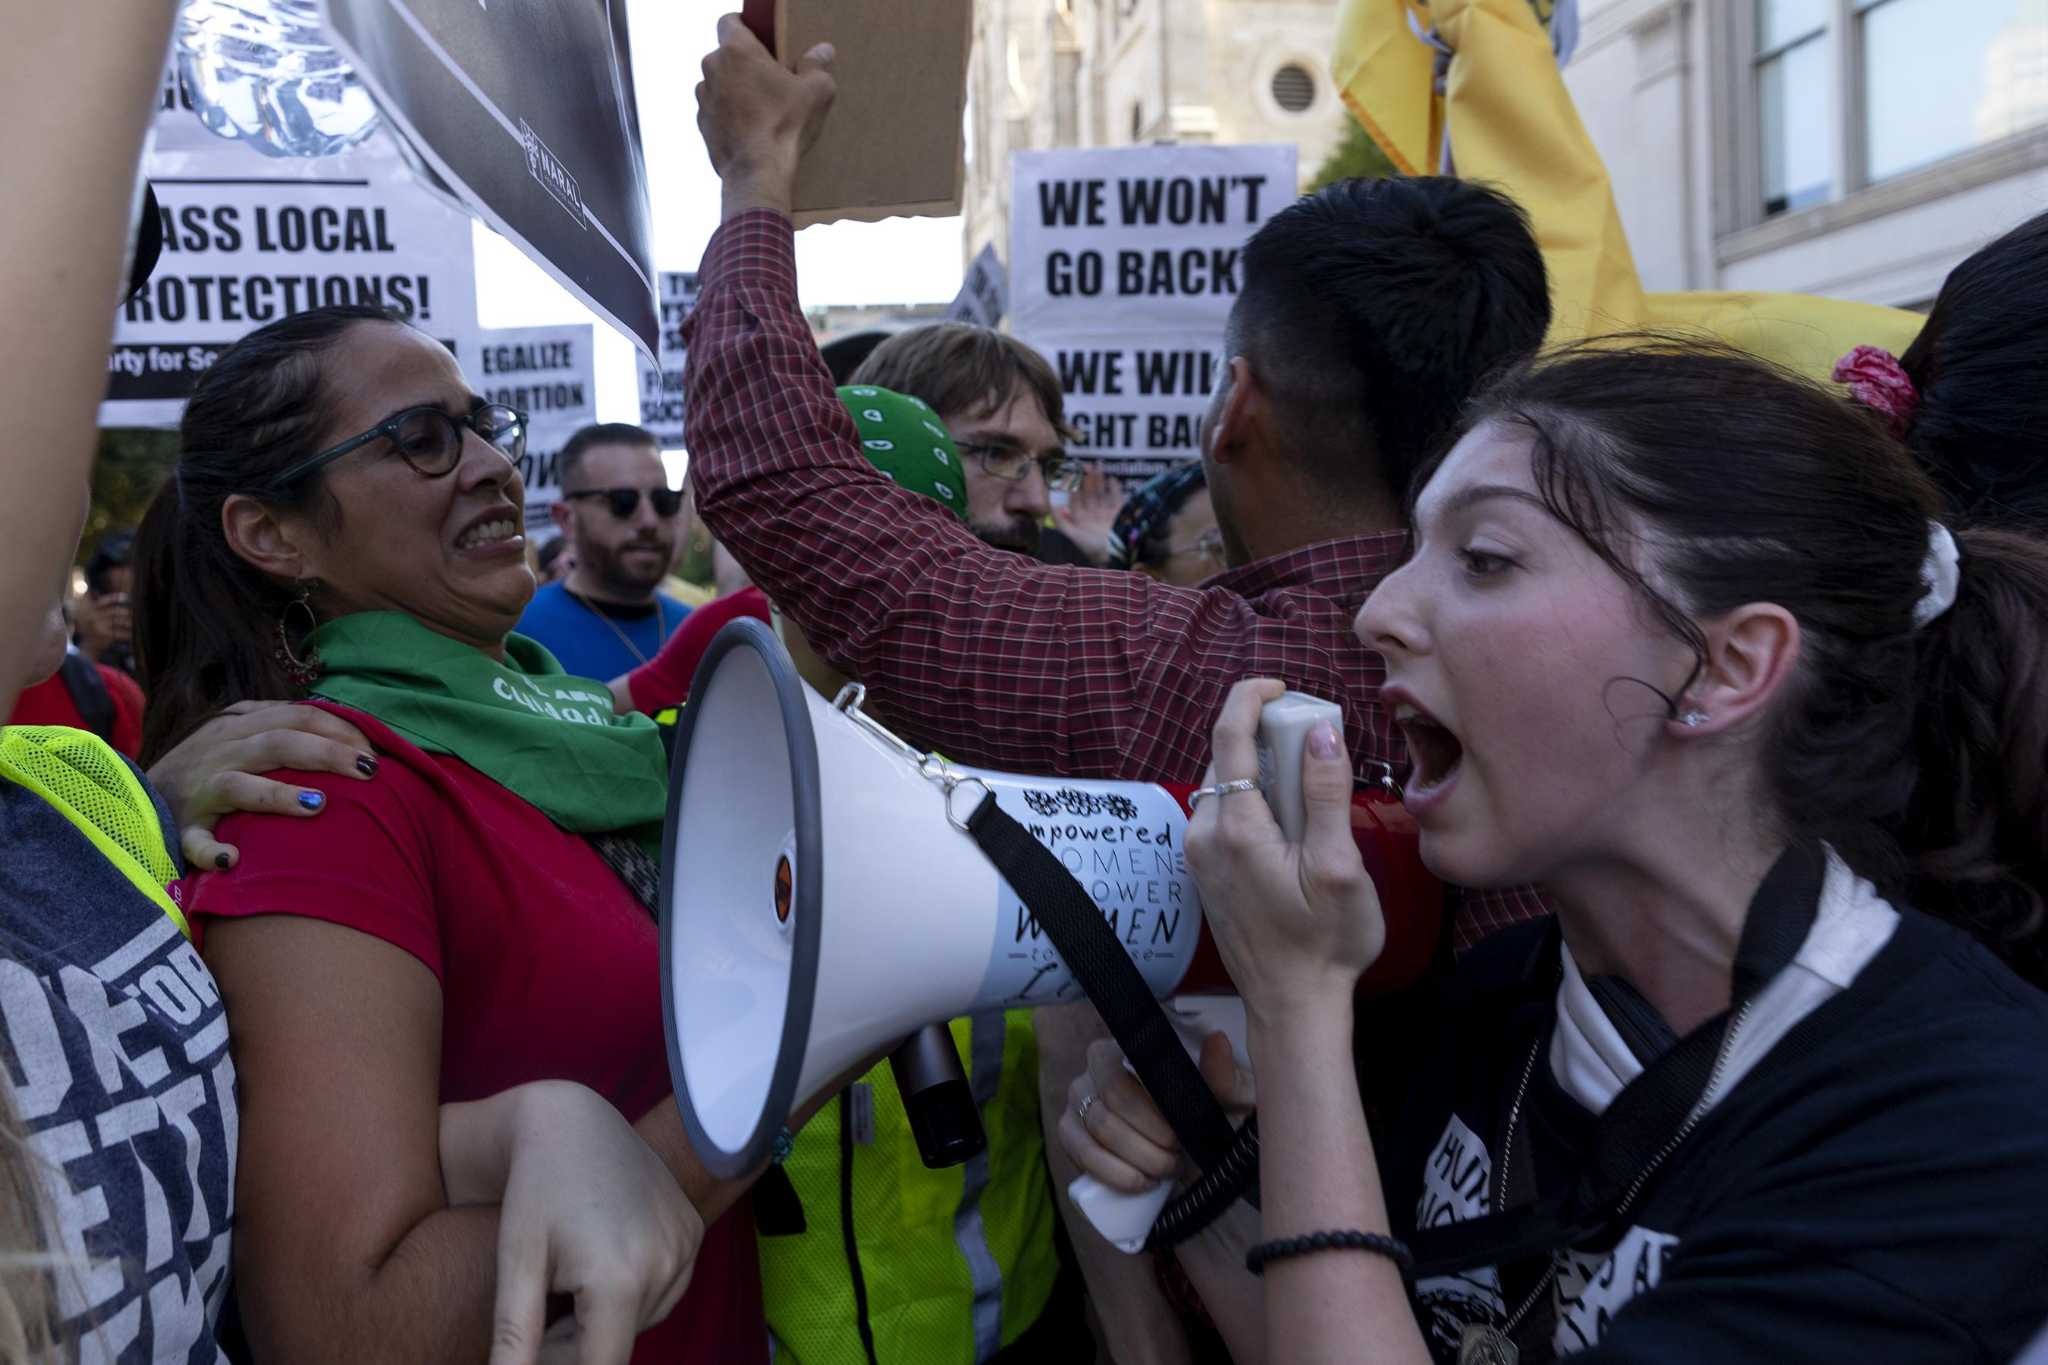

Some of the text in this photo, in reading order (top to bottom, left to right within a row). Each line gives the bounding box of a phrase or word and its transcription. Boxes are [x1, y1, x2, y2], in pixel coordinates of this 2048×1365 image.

[540, 146, 581, 210] NARAL
[1038, 175, 1267, 227] WE WON'T
[158, 205, 396, 253] ASS LOCAL
[1045, 247, 1238, 298] GO BACK
[124, 275, 431, 323] ROTECTIONS!
[148, 345, 184, 371] for
[481, 340, 573, 375] EGALIZE
[1057, 350, 1214, 396] WE WIL
[485, 380, 586, 412] ORTION
[1070, 412, 1203, 448] GHT BA
[1027, 822, 1173, 849] mpowered
[1061, 847, 1176, 875] OMEN
[1081, 880, 1184, 905] OWER
